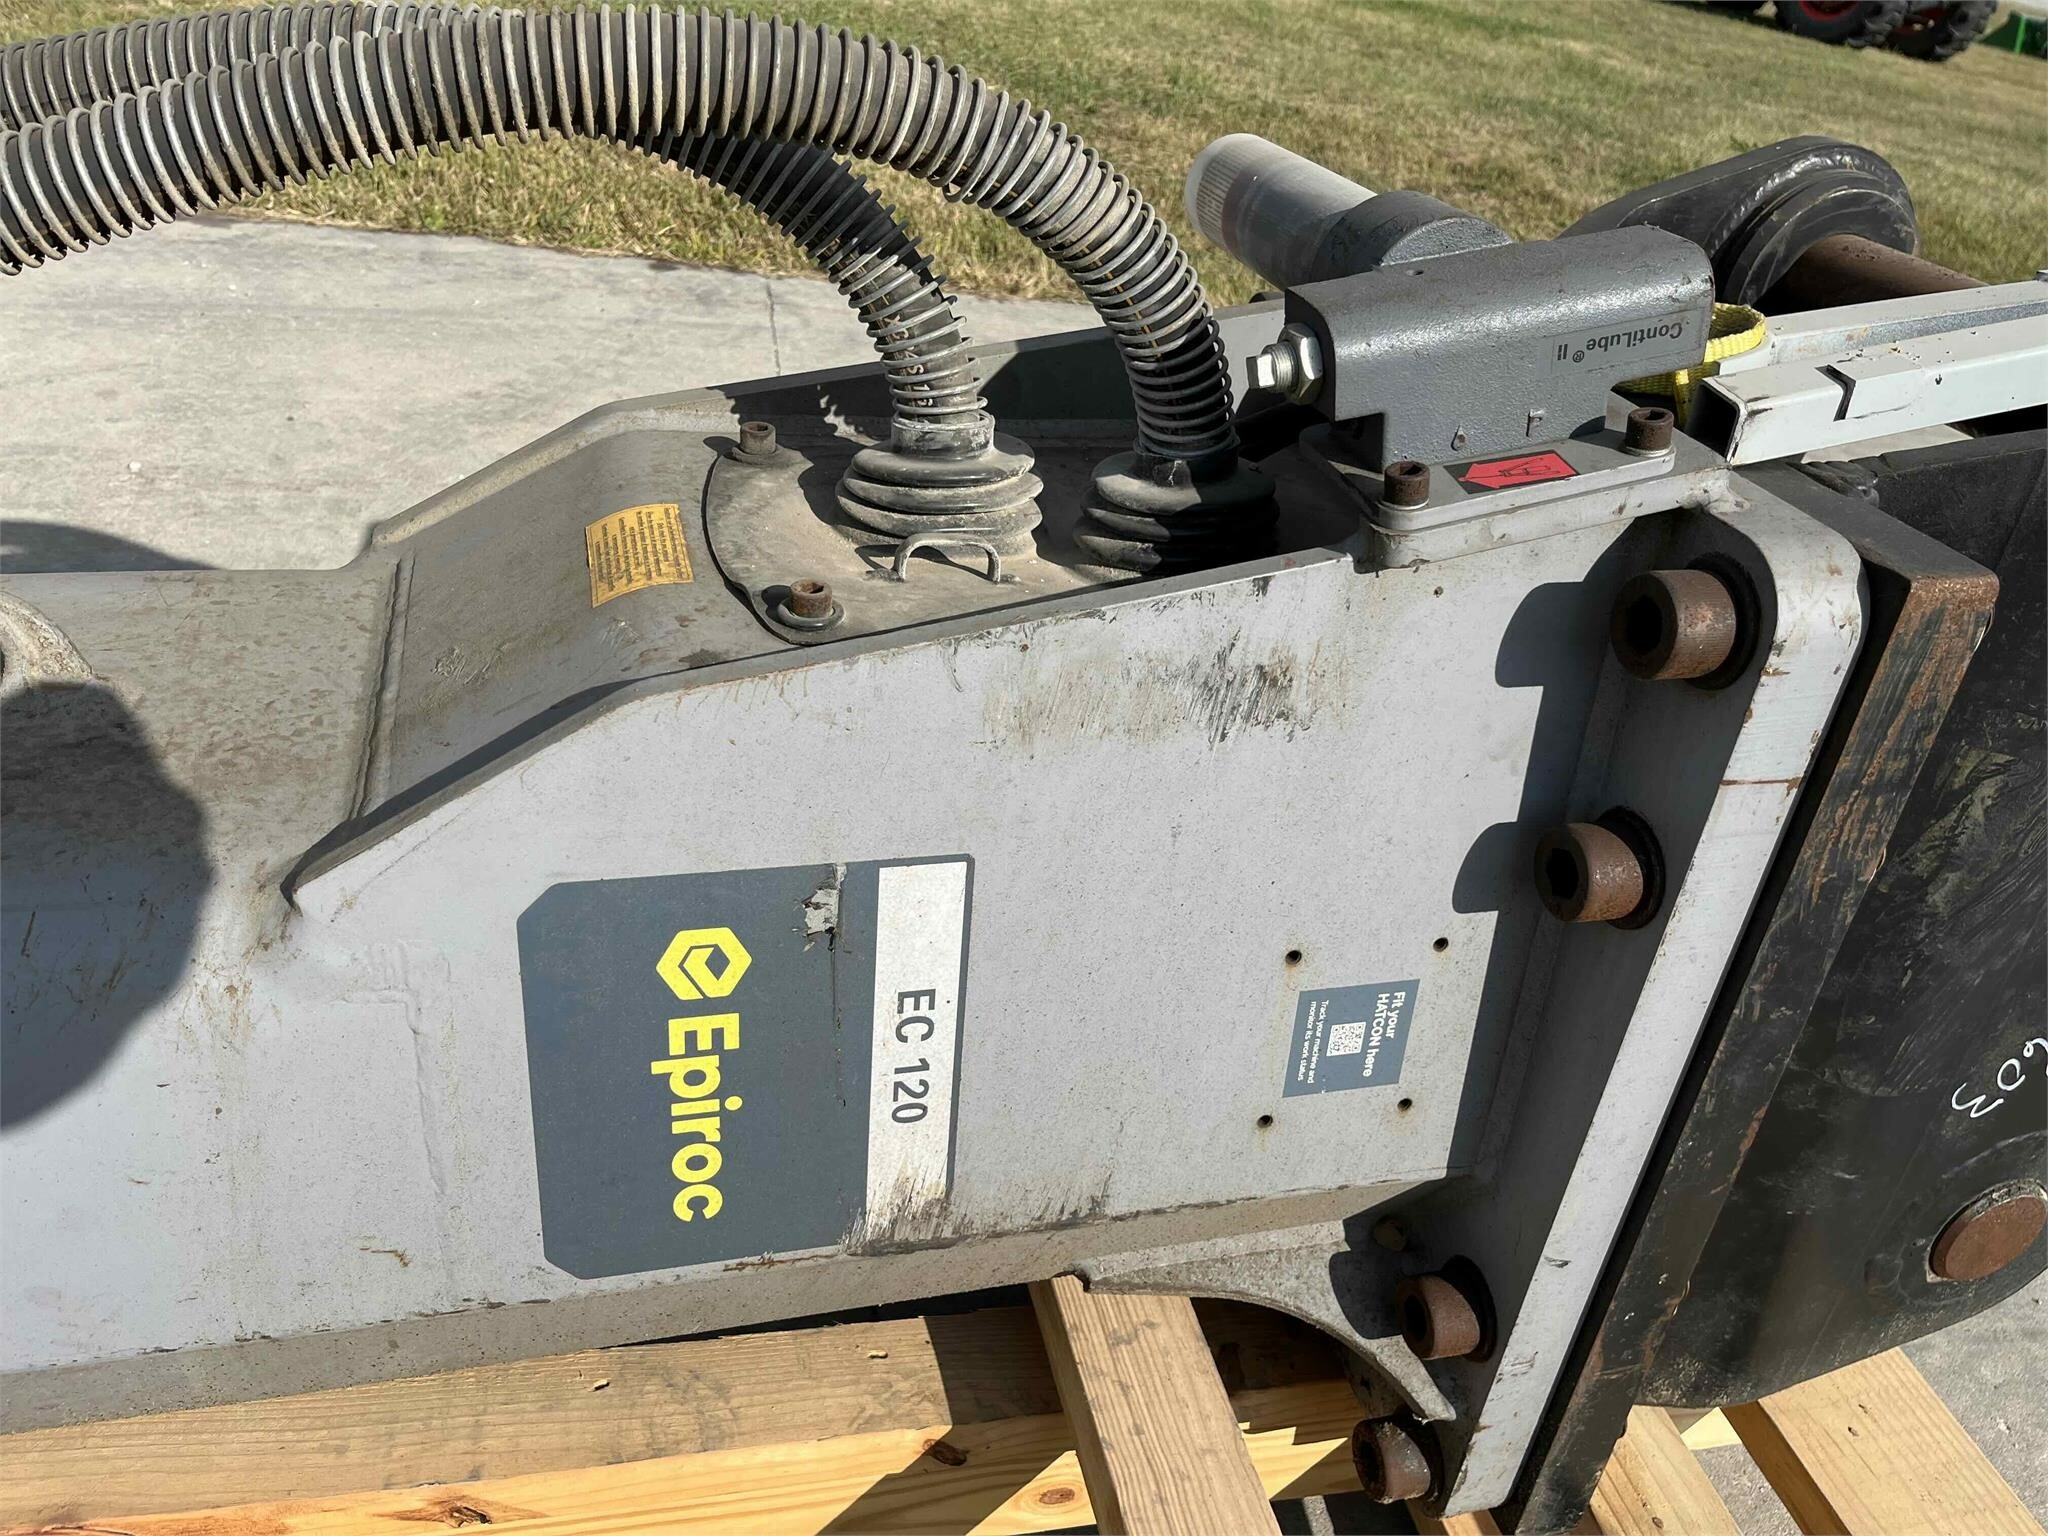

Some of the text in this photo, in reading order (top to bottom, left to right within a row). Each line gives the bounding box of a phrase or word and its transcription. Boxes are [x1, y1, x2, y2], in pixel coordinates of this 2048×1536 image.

[1557, 344, 1568, 361] II
[891, 988, 937, 1125] EC 120
[1297, 1001, 1317, 1081] monitor its work status
[1306, 1000, 1329, 1084] Track your machine and
[1362, 993, 1391, 1078] HATCON here
[1385, 991, 1406, 1039] Fit your
[650, 1012, 744, 1223] Epiroc
